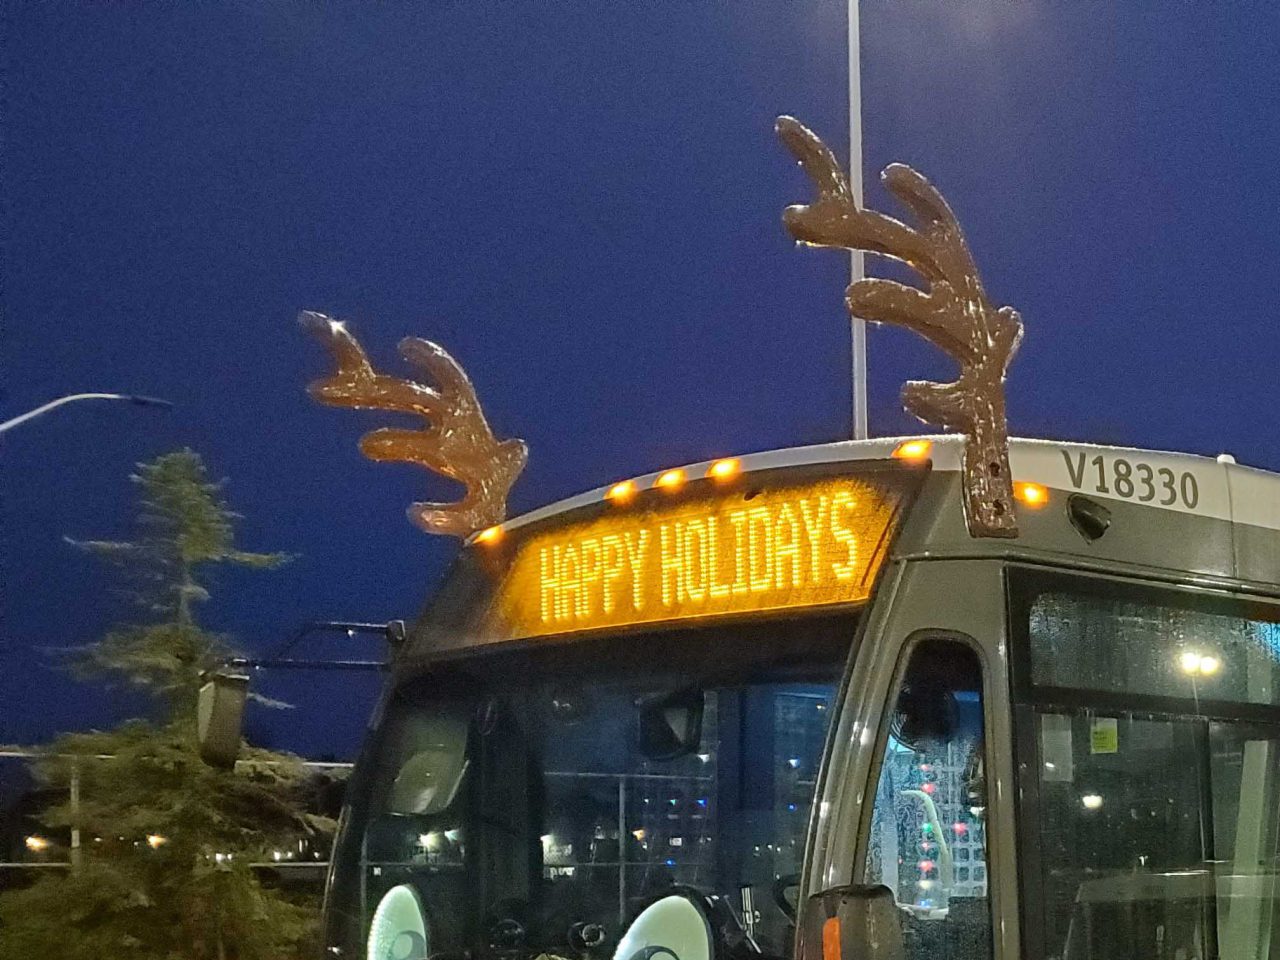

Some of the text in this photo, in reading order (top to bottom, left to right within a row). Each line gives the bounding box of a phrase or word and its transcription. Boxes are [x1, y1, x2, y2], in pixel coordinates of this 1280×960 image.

[1061, 449, 1199, 509] V18330
[540, 491, 859, 623] HAPPY HOLIDAYS
